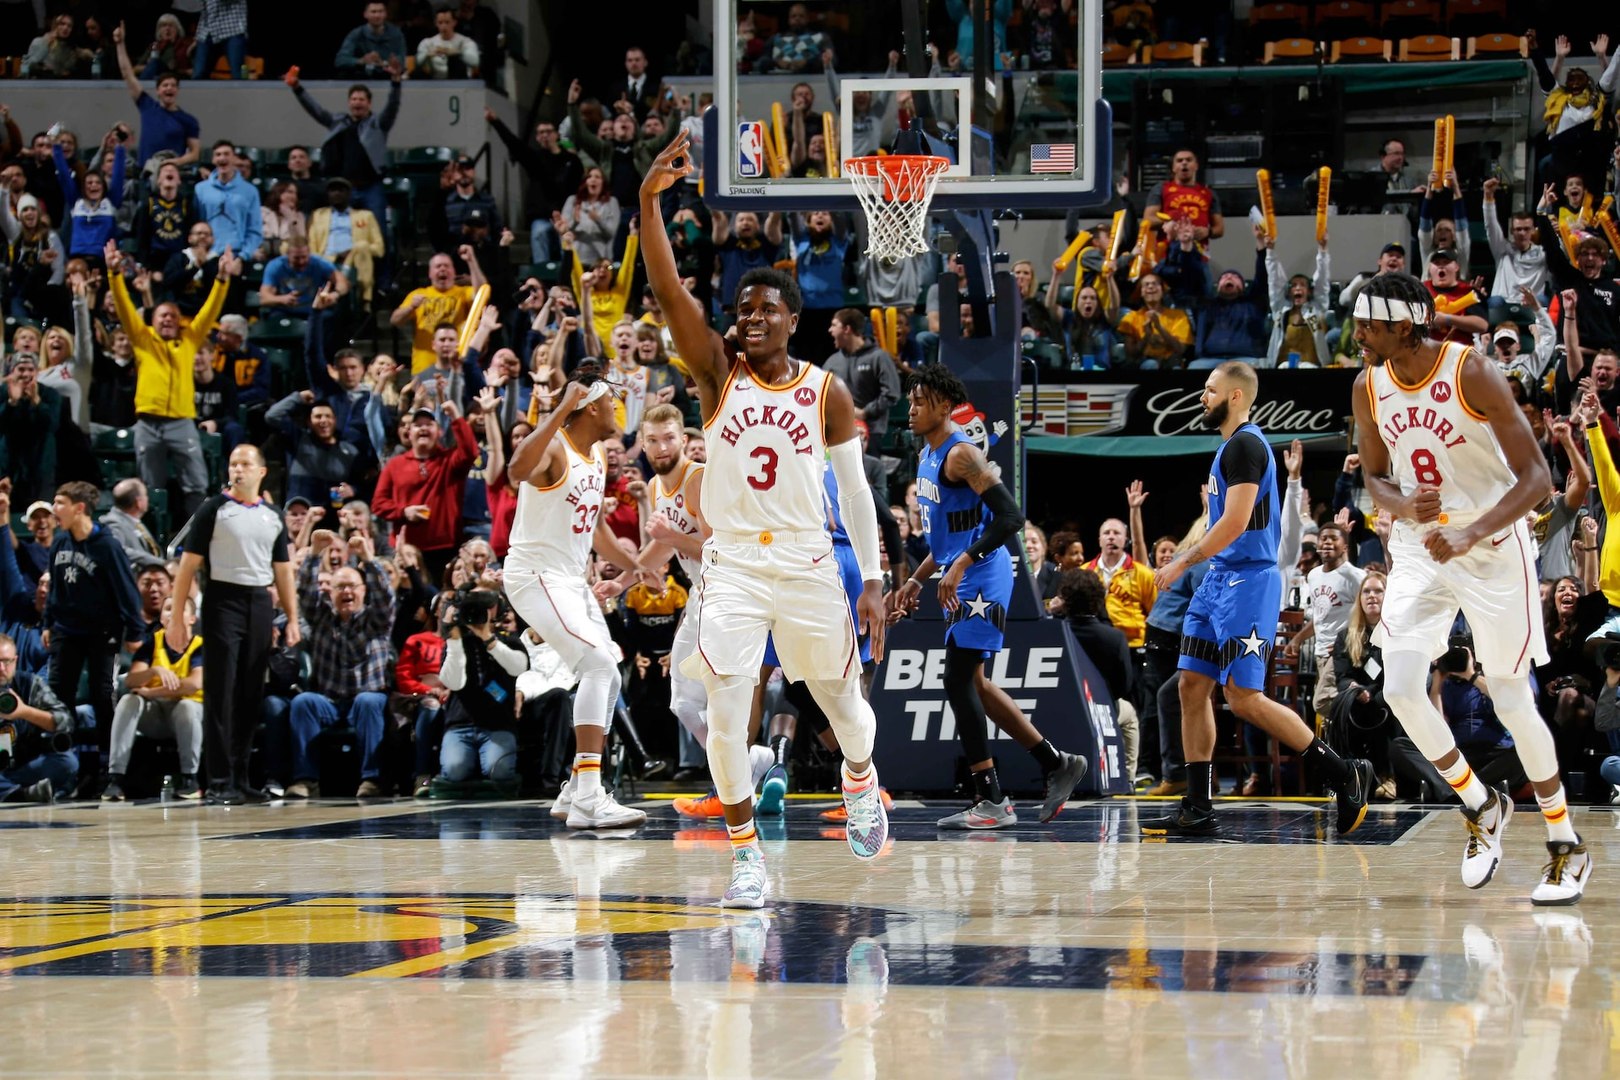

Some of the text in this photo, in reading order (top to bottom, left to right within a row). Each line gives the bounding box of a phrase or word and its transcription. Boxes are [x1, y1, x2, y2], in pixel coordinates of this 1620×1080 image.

[448, 95, 460, 126] 9
[729, 186, 766, 195] SPALDING
[720, 405, 813, 456] HICKORY
[1146, 388, 1334, 437] Caillac
[747, 446, 779, 491] 3
[1410, 448, 1443, 487] 8
[565, 475, 604, 507] HICKO
[916, 477, 941, 504] LANDO
[662, 507, 698, 536] KORY
[883, 647, 1063, 690] BELE
[904, 699, 1037, 741] TIE
